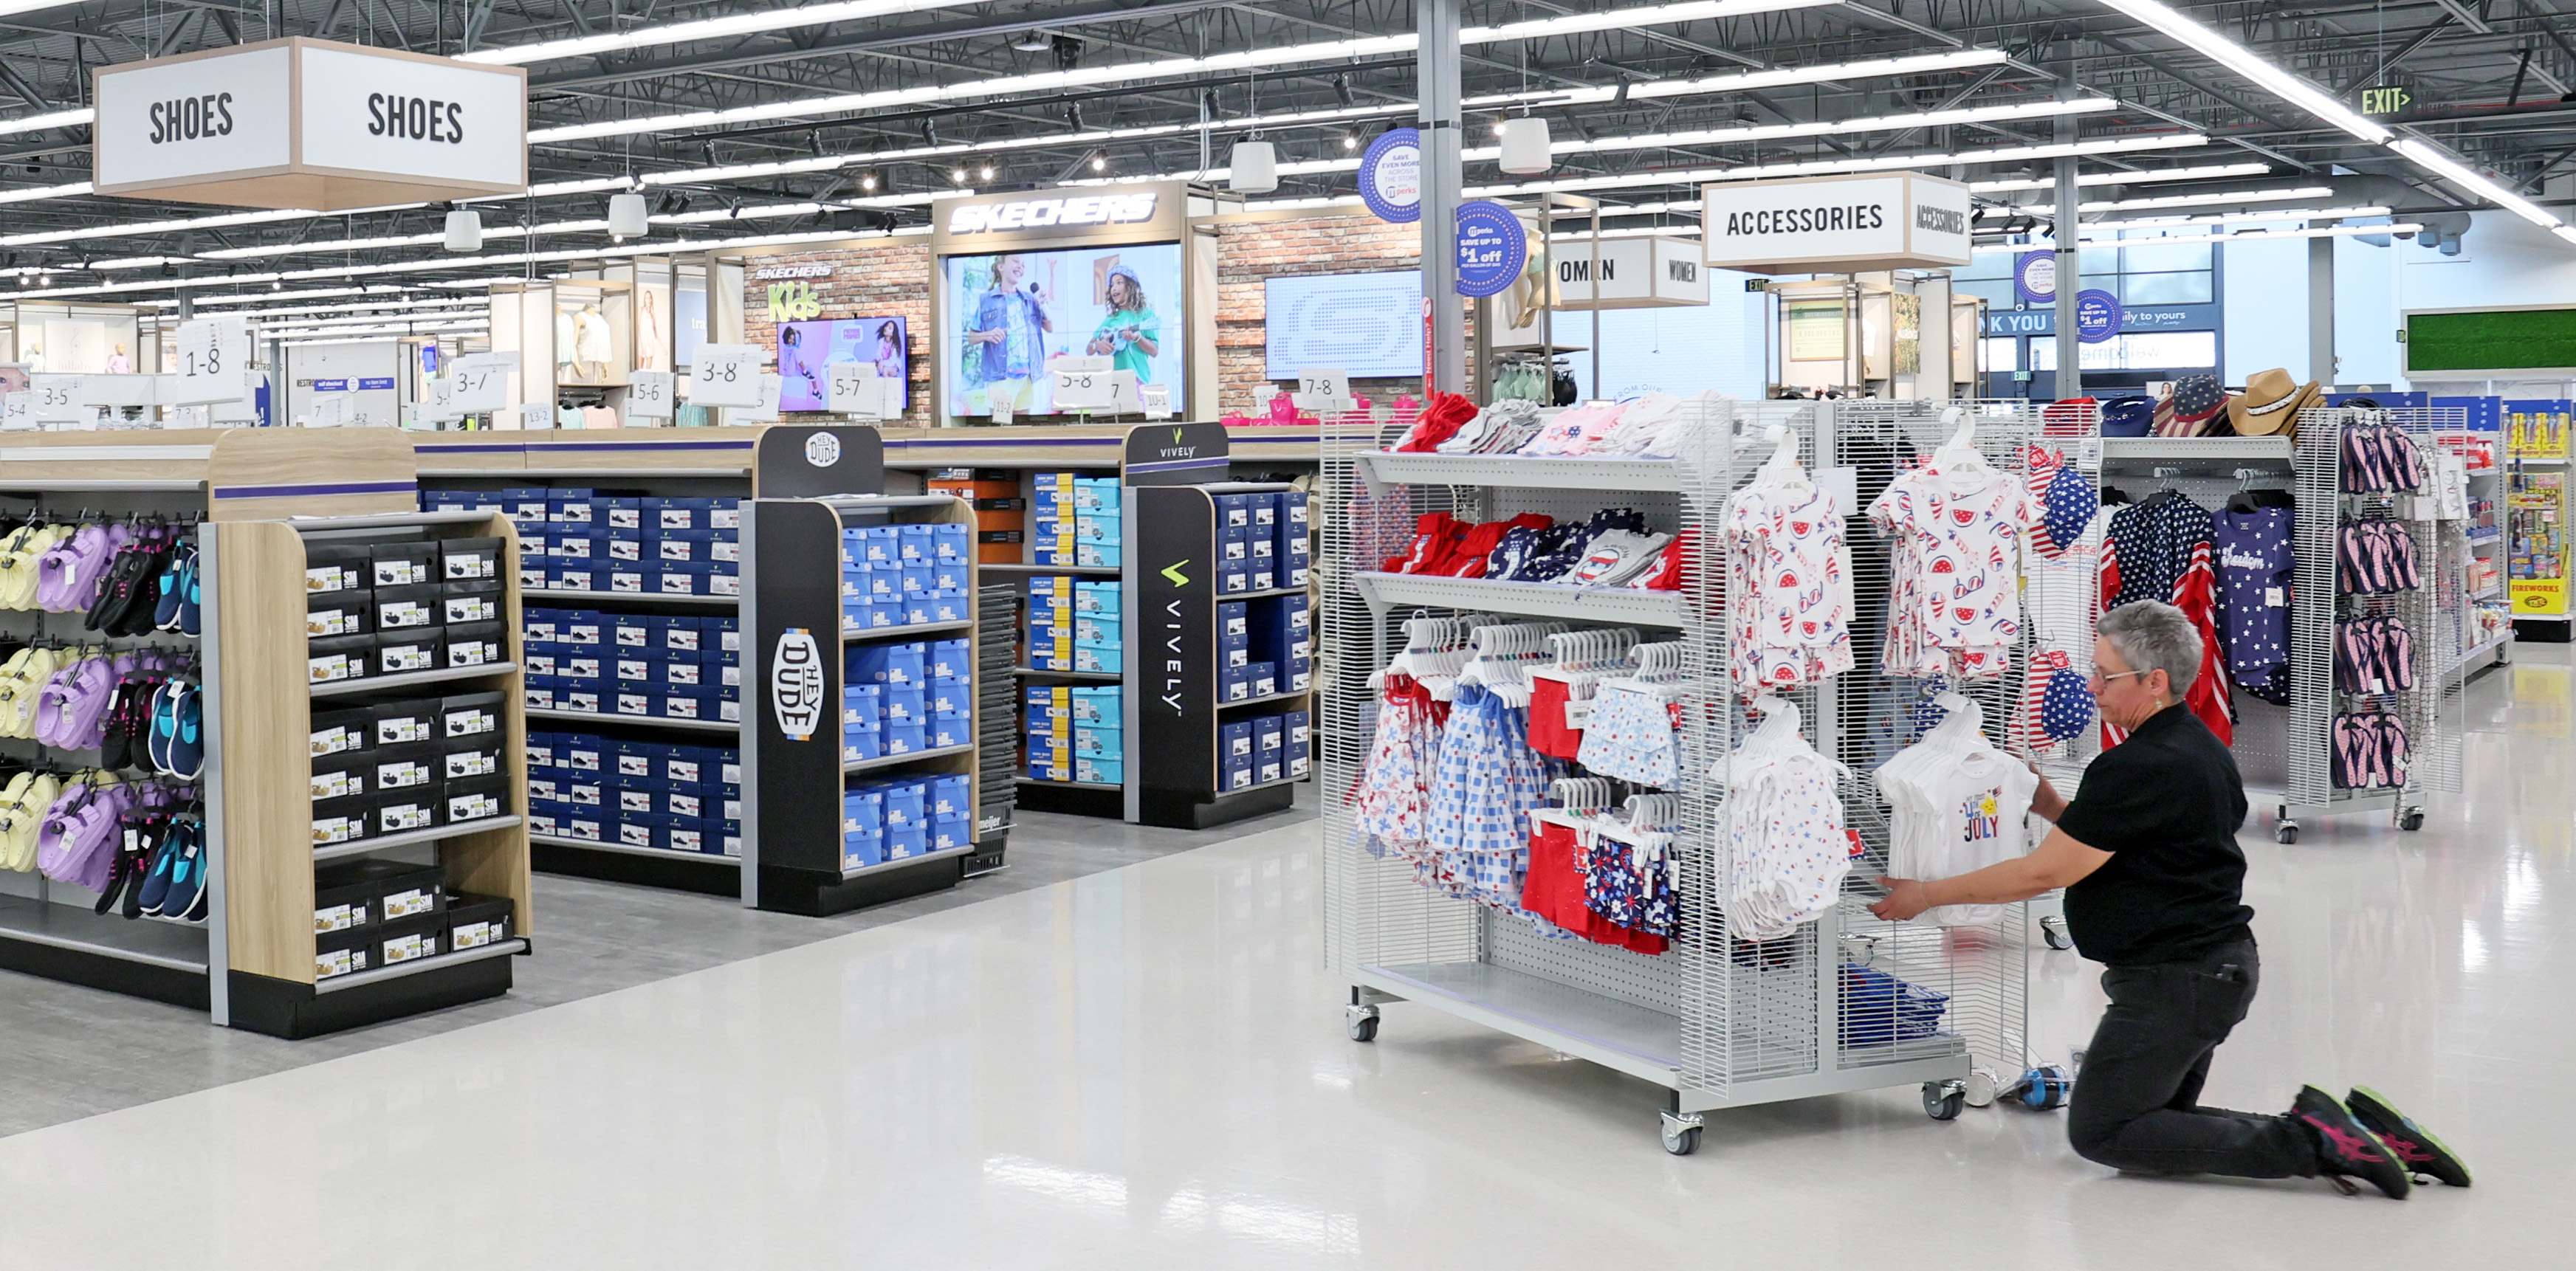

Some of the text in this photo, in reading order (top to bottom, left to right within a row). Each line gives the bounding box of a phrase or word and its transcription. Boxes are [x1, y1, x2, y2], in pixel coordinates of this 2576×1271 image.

[2363, 87, 2402, 114] EXIT
[150, 92, 233, 145] SHOES
[368, 92, 463, 145] SHOES
[949, 193, 1158, 235] SKECHERS
[1726, 204, 1883, 235] ACCESSORIES
[1916, 204, 1965, 235] ACCESSORIES
[1460, 247, 1502, 263] $1 off
[755, 264, 834, 280] SKECHERS
[1556, 258, 1615, 282] OMN
[1669, 259, 1697, 283] WOMEN
[1749, 280, 1765, 291] EXIT
[768, 280, 821, 323] Kids
[2008, 315, 2047, 331] YOU
[2141, 312, 2153, 320] to
[2155, 311, 2185, 323] yours
[186, 348, 220, 377] 1-8
[2014, 371, 2028, 381] EXIT
[638, 384, 659, 401] 5-6
[835, 378, 860, 396] 5-7
[1305, 379, 1333, 396] 7-8
[44, 388, 68, 405] 3-5
[7, 404, 26, 418] 5-4
[997, 401, 1011, 414] 11-2
[529, 410, 548, 422] 13-2
[817, 435, 831, 444] HEY
[810, 441, 836, 463] DUDE
[1160, 447, 1195, 458] VIVELY
[2221, 546, 2264, 569] Freedom
[412, 565, 426, 578] SM
[481, 559, 494, 573] SM
[343, 570, 357, 585] SM
[2512, 585, 2560, 593] FIREWORKS
[416, 607, 430, 621] SM
[482, 602, 495, 615] SM
[345, 615, 359, 629] SM
[484, 644, 497, 656] SM
[1161, 599, 1181, 710] VIVELY
[419, 651, 432, 664] SM
[349, 658, 363, 672] SM
[778, 641, 811, 726] DUDE
[806, 665, 820, 712] HEY
[481, 714, 495, 727] SM
[416, 723, 430, 736] SM
[347, 731, 362, 745] SM
[482, 756, 495, 768] SM
[416, 766, 429, 779] SM
[348, 776, 363, 790] SM
[484, 798, 498, 810] SM
[418, 808, 431, 822] SM
[349, 820, 363, 833] SM
[1964, 815, 1999, 842] JULY
[420, 893, 433, 906] SM
[352, 906, 366, 921] SM
[490, 923, 503, 937] SM
[422, 937, 436, 951] SM
[352, 951, 366, 965] SM
